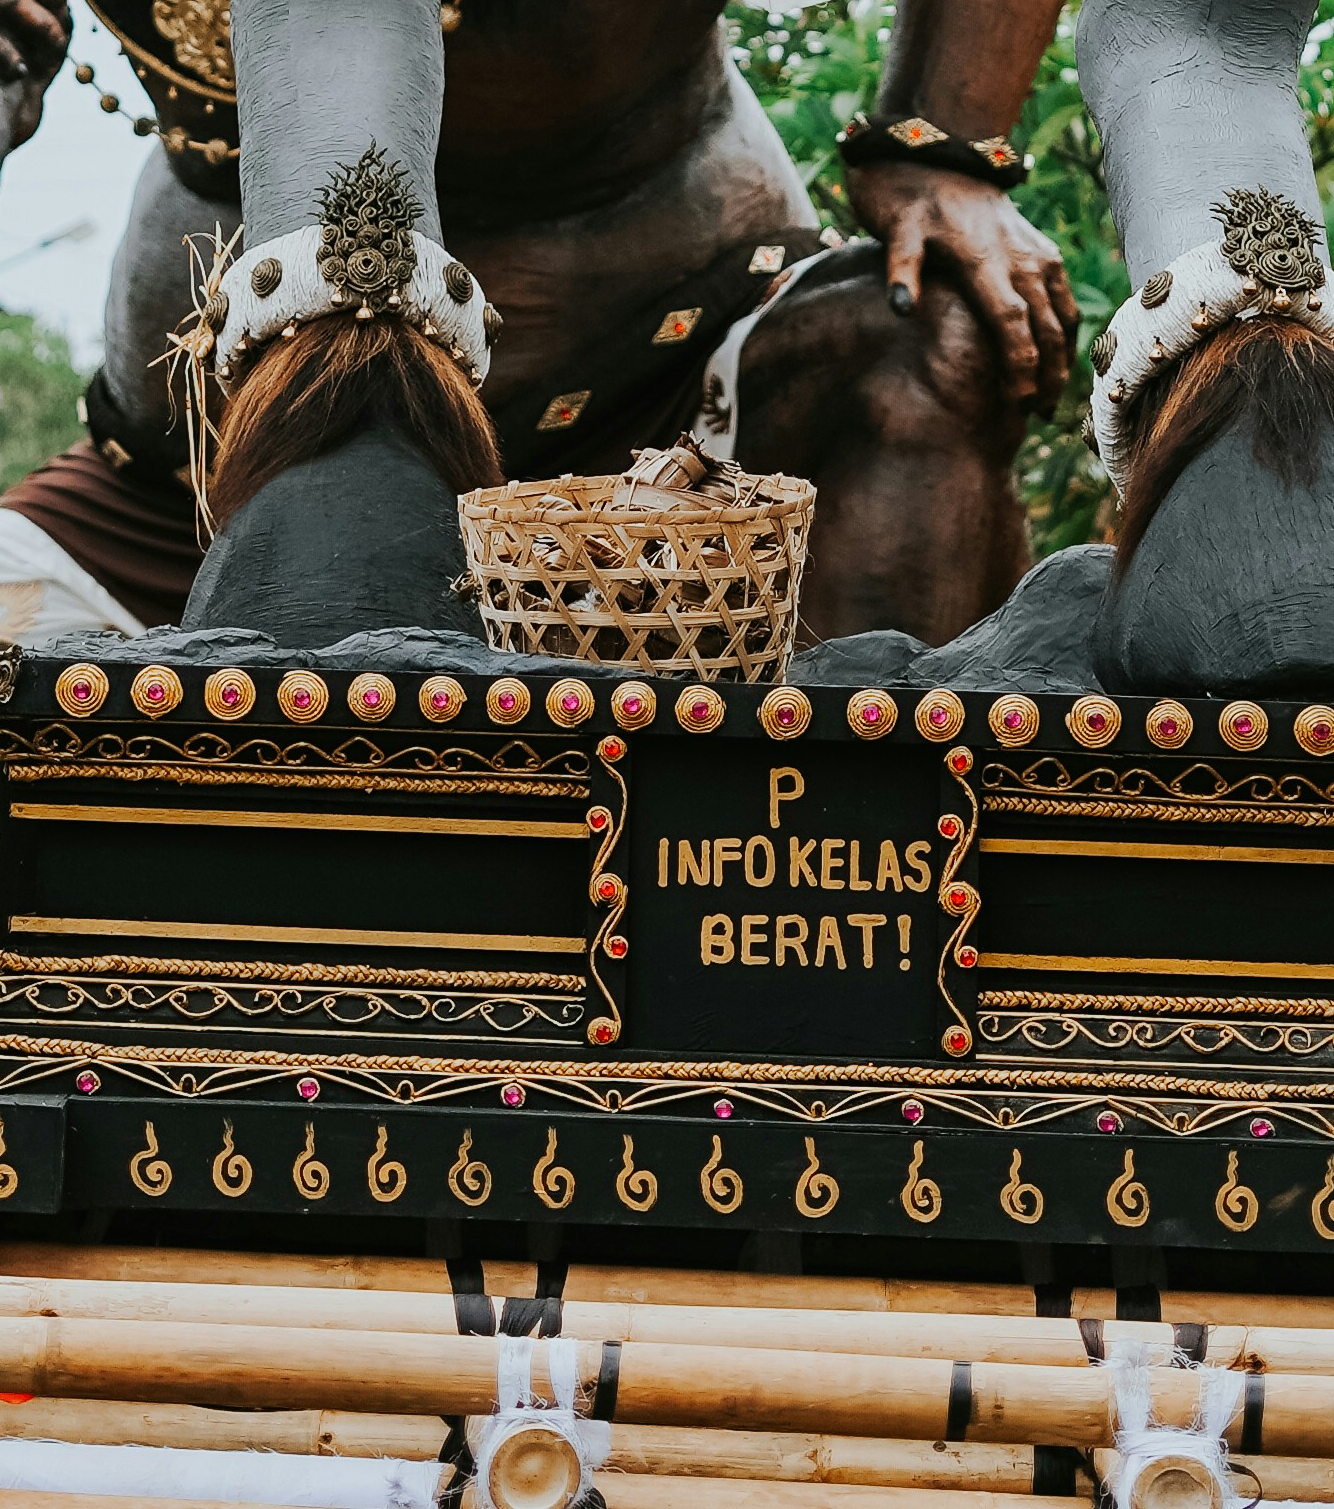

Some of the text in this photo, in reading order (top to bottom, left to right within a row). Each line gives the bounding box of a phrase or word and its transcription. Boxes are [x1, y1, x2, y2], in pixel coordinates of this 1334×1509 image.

[769, 766, 805, 829] P
[657, 834, 932, 893] INFO KELAS
[700, 912, 913, 972] BERAT!
